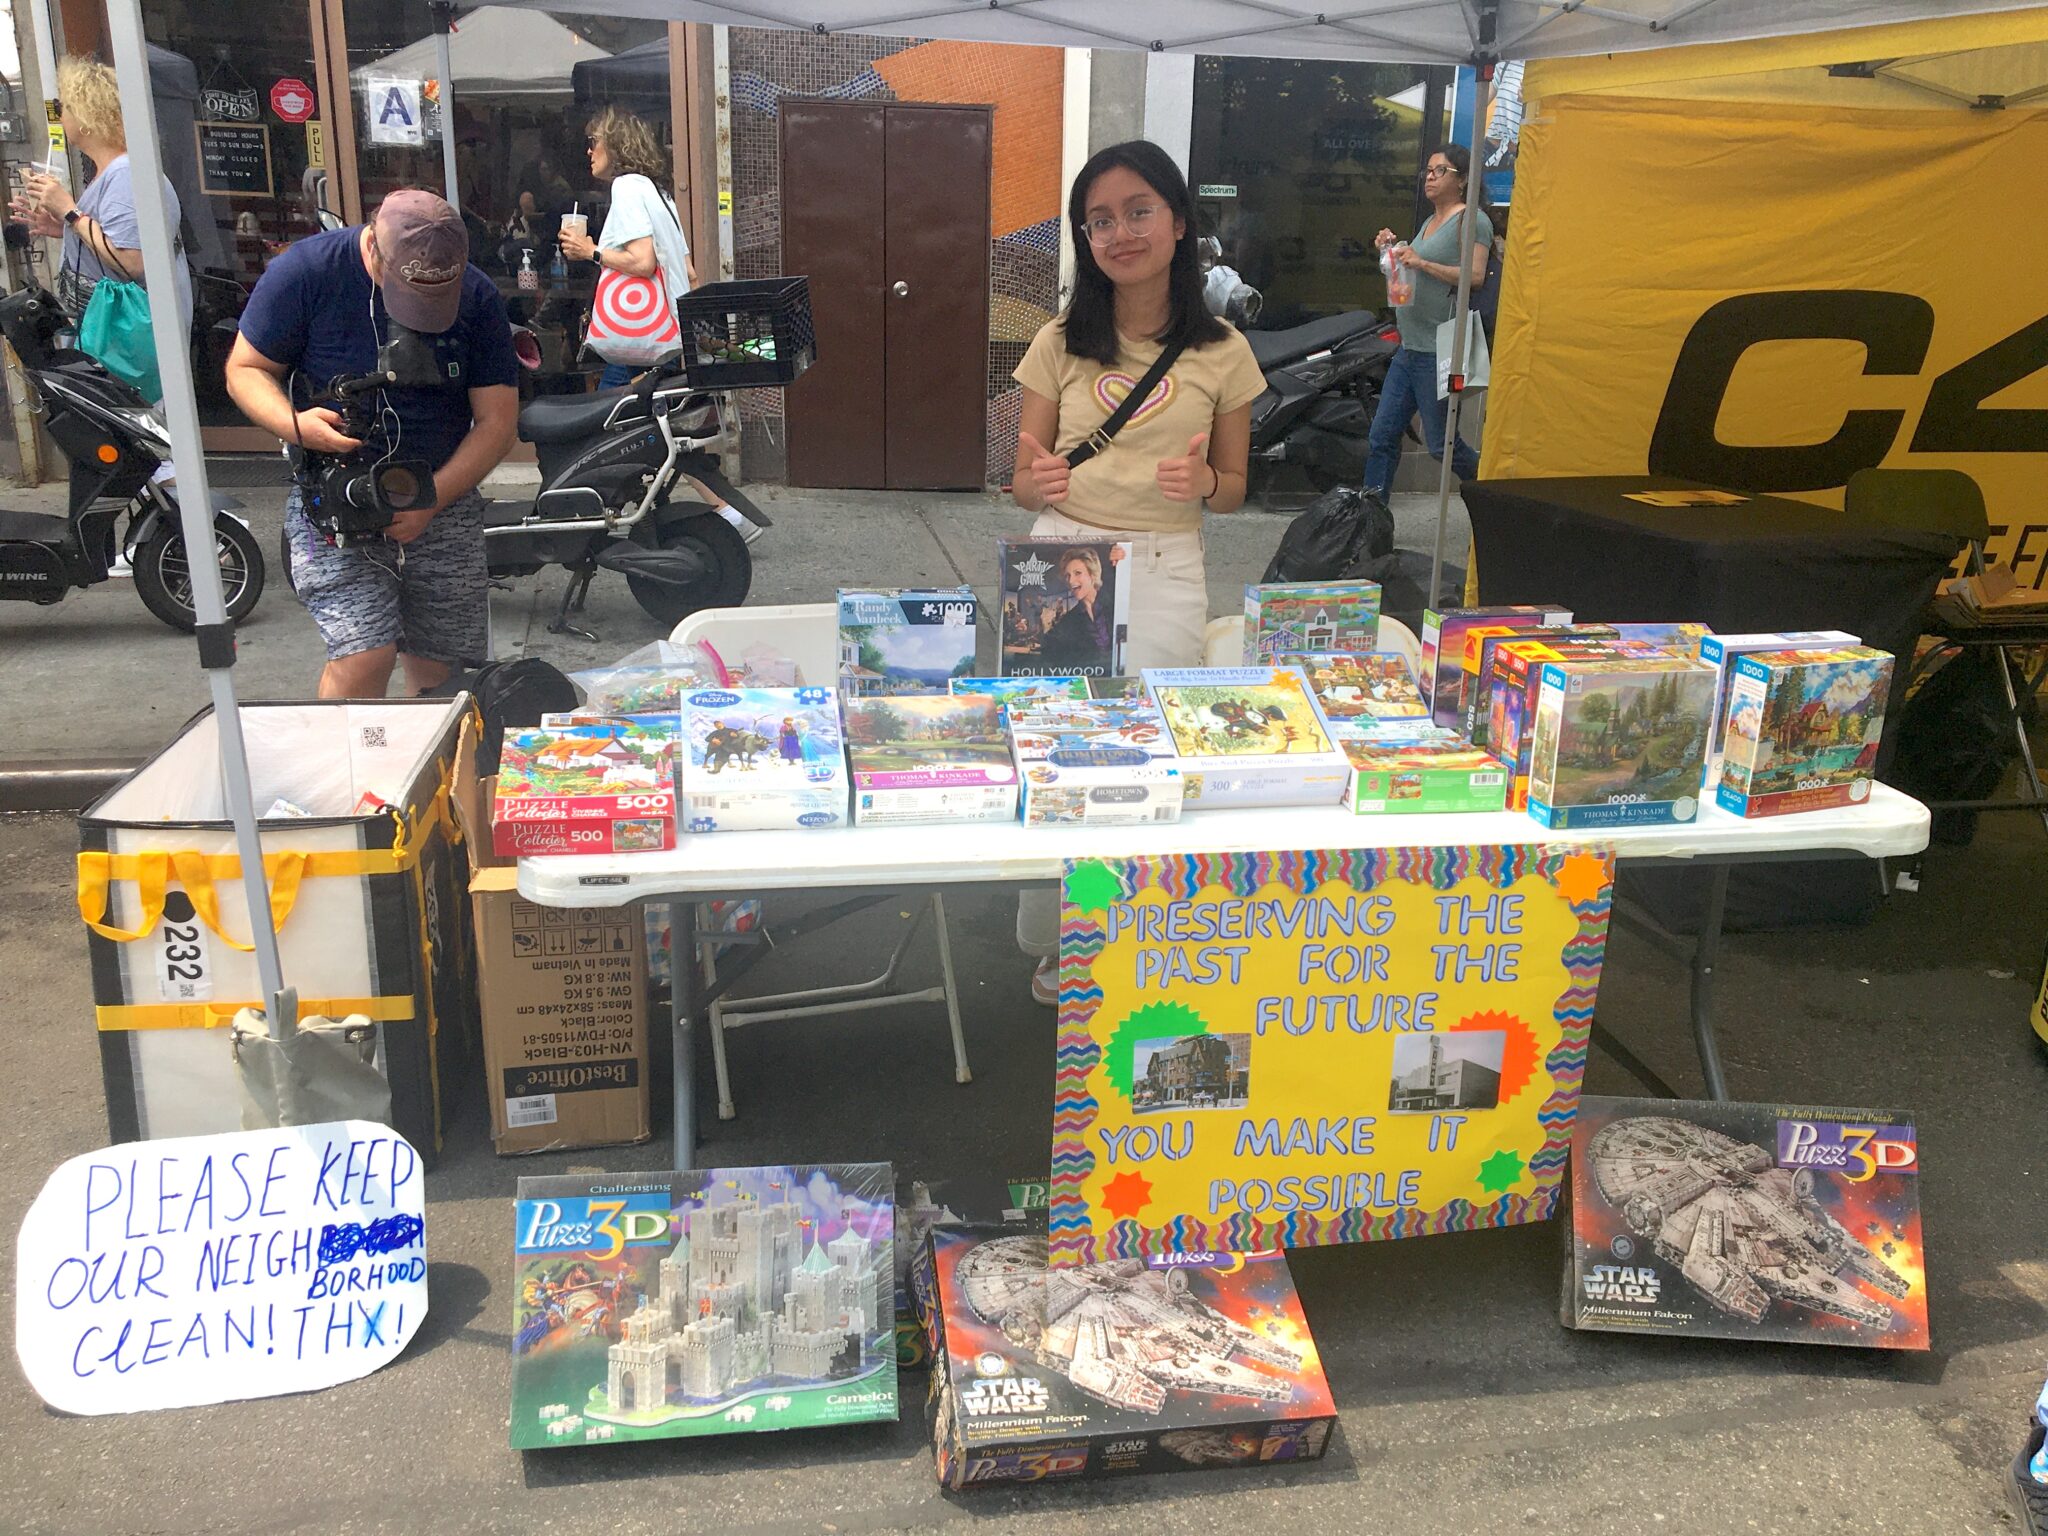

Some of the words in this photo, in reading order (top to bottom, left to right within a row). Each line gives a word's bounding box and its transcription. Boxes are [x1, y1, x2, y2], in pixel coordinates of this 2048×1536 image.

[206, 98, 252, 117] OPEN
[379, 87, 413, 126] A
[312, 128, 321, 163] PULL
[209, 169, 228, 177] THANK
[1200, 185, 1236, 196] Spectrum
[1020, 560, 1049, 574] PARTY
[6, 572, 48, 581] WING
[1020, 574, 1046, 586] GAME
[854, 600, 892, 615] Randy
[855, 613, 902, 624] Vanbeck
[1702, 643, 1720, 659] 1000
[1512, 658, 1525, 671] 550
[1742, 663, 1765, 678] 1000
[1010, 666, 1105, 677] HOLLYWOOD
[1187, 669, 1227, 677] FORMAT
[1545, 671, 1562, 687] 1000
[695, 696, 736, 704] FROZEN
[802, 689, 823, 699] 48
[1466, 704, 1475, 731] 550
[807, 767, 832, 778] 3D
[890, 773, 929, 782] THOMAS
[938, 771, 982, 780] KINKADE
[1209, 780, 1230, 792] 300
[1796, 779, 1821, 790] 1000
[1096, 788, 1143, 797] HOMETOWN
[1607, 793, 1637, 804] 1000
[503, 800, 569, 811] PUZZLE
[616, 795, 669, 810] 500
[502, 808, 568, 821] Collector
[1583, 811, 1618, 819] THOMAS
[1627, 807, 1667, 817] KINKADE
[512, 822, 567, 836] PUZZLE
[510, 833, 568, 848] Collector
[571, 830, 604, 842] 500
[1106, 896, 1396, 944] PRESERVING
[1434, 894, 1525, 936] THE
[164, 926, 203, 982] 232
[532, 958, 580, 970] Vietnam
[601, 956, 631, 967] Made
[1136, 945, 1250, 989] PAST
[1299, 945, 1391, 985] FOR
[1431, 943, 1522, 983] THE
[564, 974, 583, 985] KG
[585, 972, 604, 984] 8.8
[608, 971, 632, 982] NW:
[564, 988, 584, 999] KG
[587, 987, 603, 998] 9.5
[606, 986, 632, 997] GW:
[517, 1006, 534, 1015] cm
[538, 1001, 594, 1015] 58x24x48
[596, 999, 632, 1010] Meas:
[1256, 992, 1439, 1037] FUTURE
[524, 1043, 632, 1060] VN-H03-Black
[527, 1064, 628, 1088] BestOffice
[1099, 1119, 1194, 1165] YOU
[1233, 1116, 1377, 1157] MAKE
[1427, 1116, 1467, 1152] IT
[85, 1146, 291, 1251] PLEASE
[313, 1138, 415, 1211] KEEP
[589, 1183, 672, 1194] Challenging
[1209, 1170, 1421, 1215] POSSIBLE
[48, 1246, 167, 1311] OUR
[307, 1257, 426, 1301] BORHOOD
[1583, 1265, 1660, 1286] STAR
[1583, 1281, 1661, 1303] WARS
[1582, 1305, 1652, 1317] Millennium
[296, 1299, 405, 1360] THX!
[962, 1377, 1049, 1399] STAR
[826, 1391, 894, 1406] Camelot
[962, 1394, 1050, 1416] WARS
[967, 1417, 1043, 1430] Millennium
